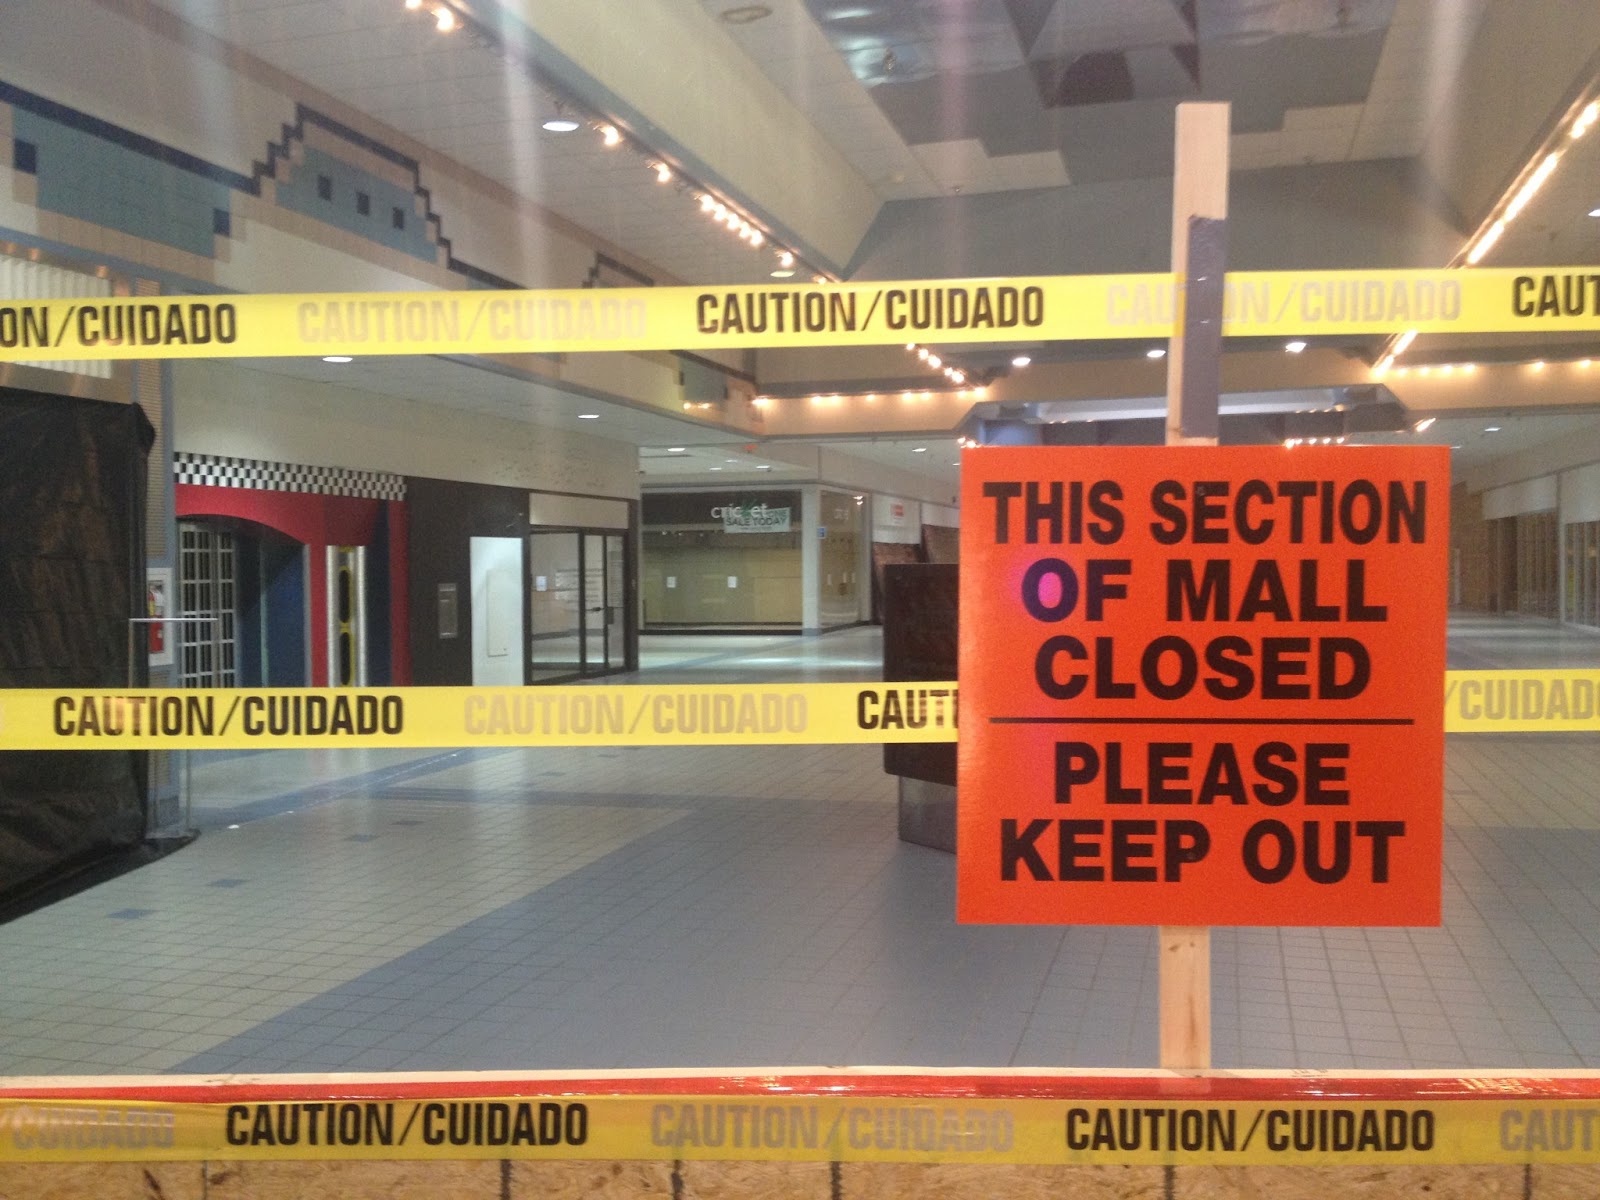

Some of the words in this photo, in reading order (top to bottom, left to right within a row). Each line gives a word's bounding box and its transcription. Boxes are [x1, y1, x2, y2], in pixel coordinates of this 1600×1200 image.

[297, 298, 647, 343] CAUTION/CUIDADO
[697, 286, 1044, 334] CAUTION/CUIDADO
[726, 517, 750, 527] SALE
[752, 516, 787, 526] TODAY
[983, 480, 1125, 545] THIS
[1149, 480, 1427, 545] SECTION
[1021, 558, 1132, 623] OF
[1166, 559, 1388, 622] MALL
[1034, 635, 1371, 700] CLOSED
[53, 695, 403, 736] CAUTION/CUIDADO
[463, 692, 808, 735] CAUTION/CUIDADO
[1055, 741, 1350, 806] PLEASE
[1000, 819, 1211, 882] KEEP
[1241, 819, 1405, 884] OUT
[226, 1102, 588, 1146] CAUTION/CUIDADO
[651, 1104, 1014, 1152] CAUTION/CUIDADO
[1066, 1108, 1435, 1152] CAUTION/CUIDADO
